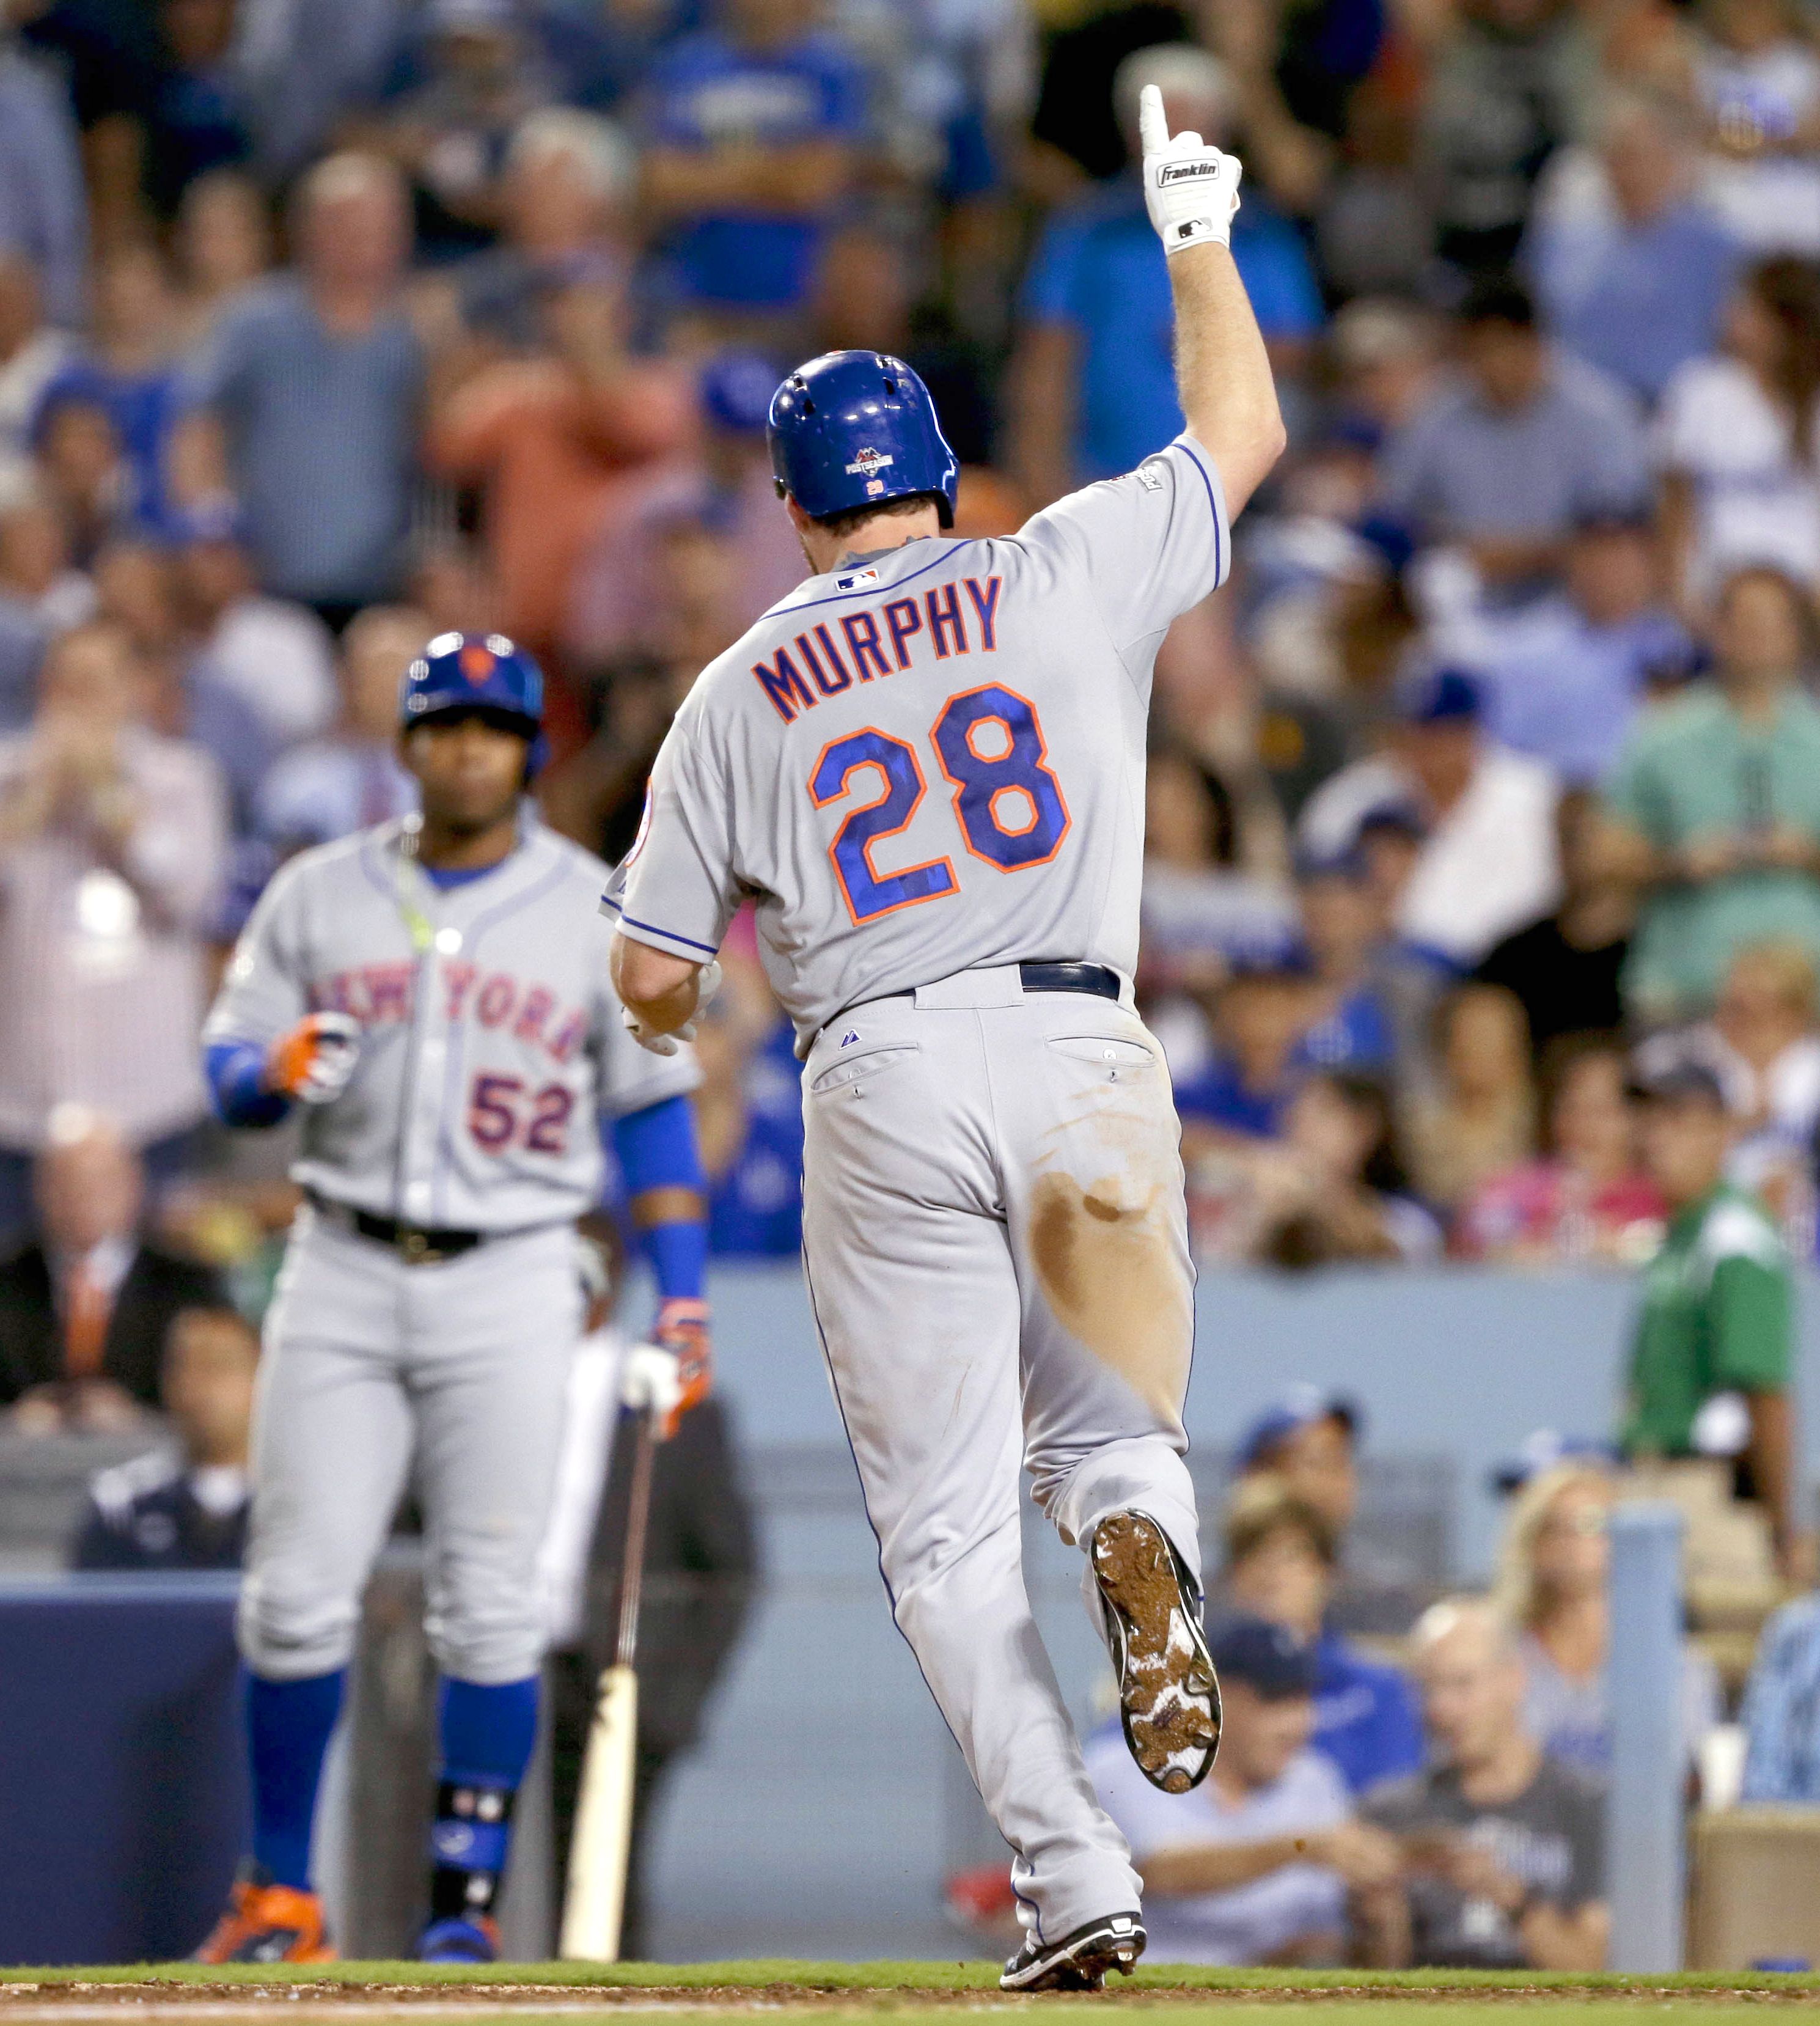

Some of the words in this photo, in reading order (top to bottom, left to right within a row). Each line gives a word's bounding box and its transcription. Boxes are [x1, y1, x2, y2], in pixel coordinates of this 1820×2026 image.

[750, 576, 1002, 725] MURPHY
[805, 680, 1073, 928] 28
[468, 1071, 574, 1154] 52
